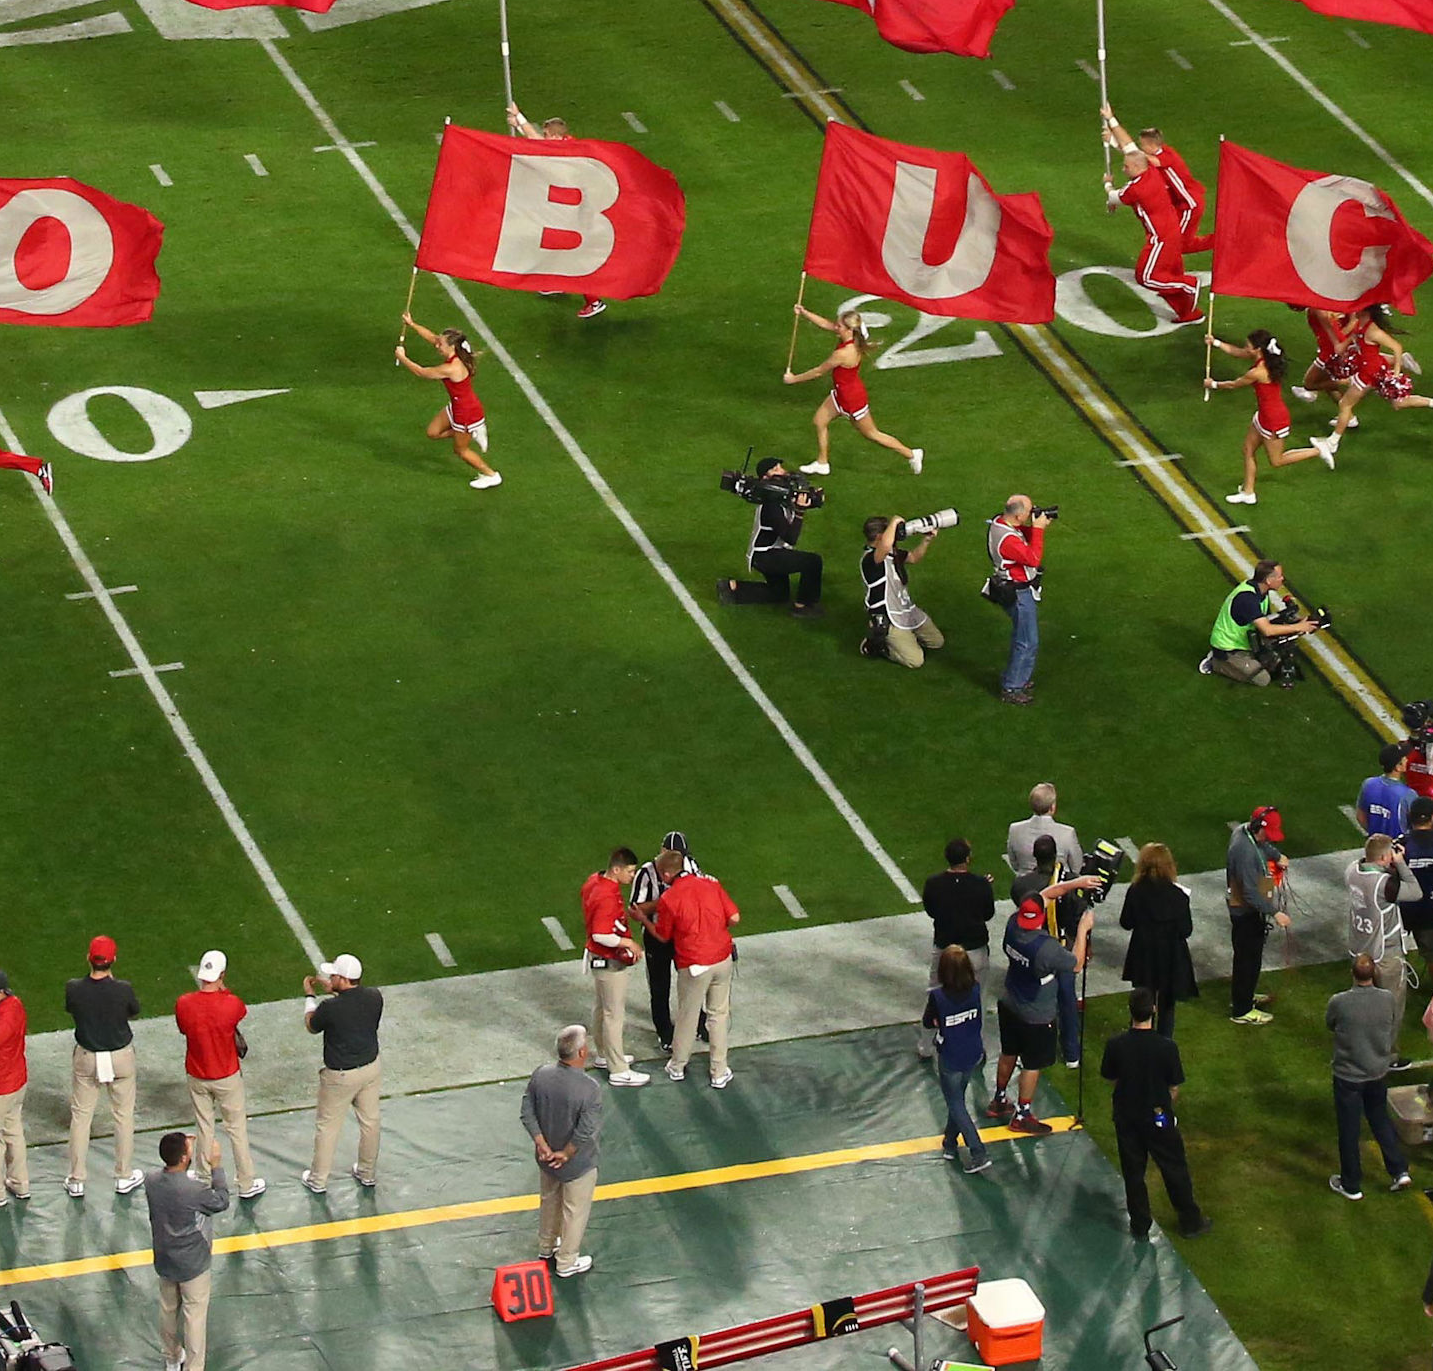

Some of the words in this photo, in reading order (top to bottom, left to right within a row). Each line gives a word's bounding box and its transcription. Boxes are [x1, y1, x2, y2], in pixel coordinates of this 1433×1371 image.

[492, 154, 619, 277] B
[881, 161, 1002, 300] U
[1286, 175, 1396, 302] C
[944, 1008, 978, 1027] ESPN
[504, 1269, 550, 1314] 30
